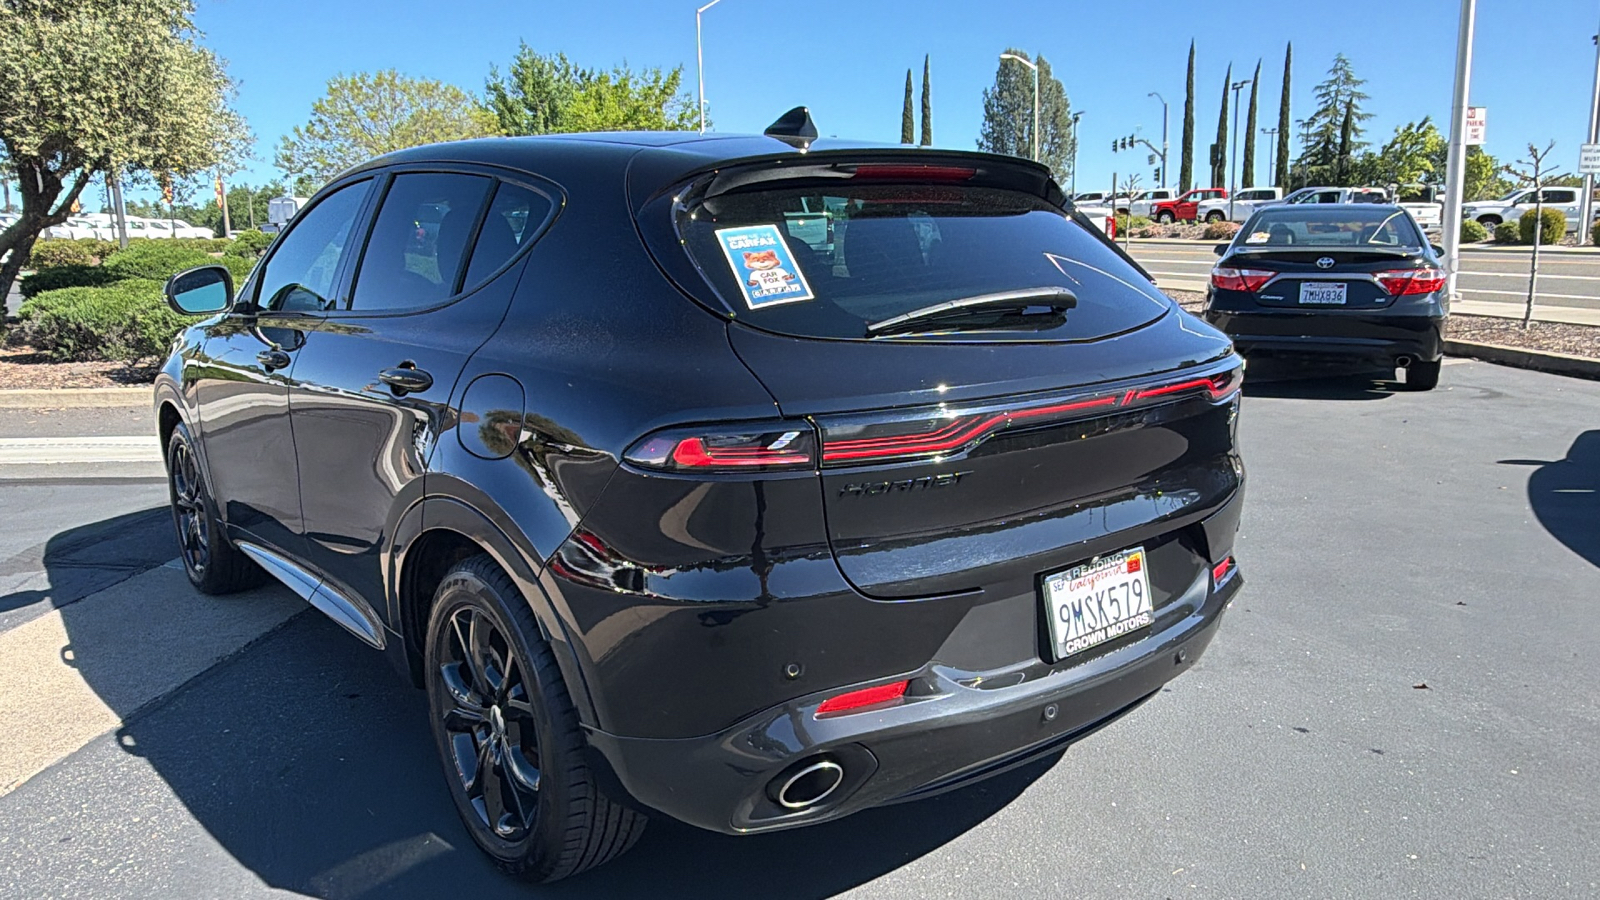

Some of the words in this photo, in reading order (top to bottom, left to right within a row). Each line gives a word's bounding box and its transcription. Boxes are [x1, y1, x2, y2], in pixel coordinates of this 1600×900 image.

[729, 237, 777, 250] CARFAX
[1303, 290, 1343, 301] 7MHX836
[838, 470, 975, 497] HORNET
[1072, 554, 1124, 578] REDDING
[1053, 579, 1065, 592] SEP
[1068, 566, 1126, 592] California
[1059, 578, 1143, 642] 9MSK579
[1065, 627, 1106, 653] CROWN
[1107, 612, 1149, 637] MOTORS
